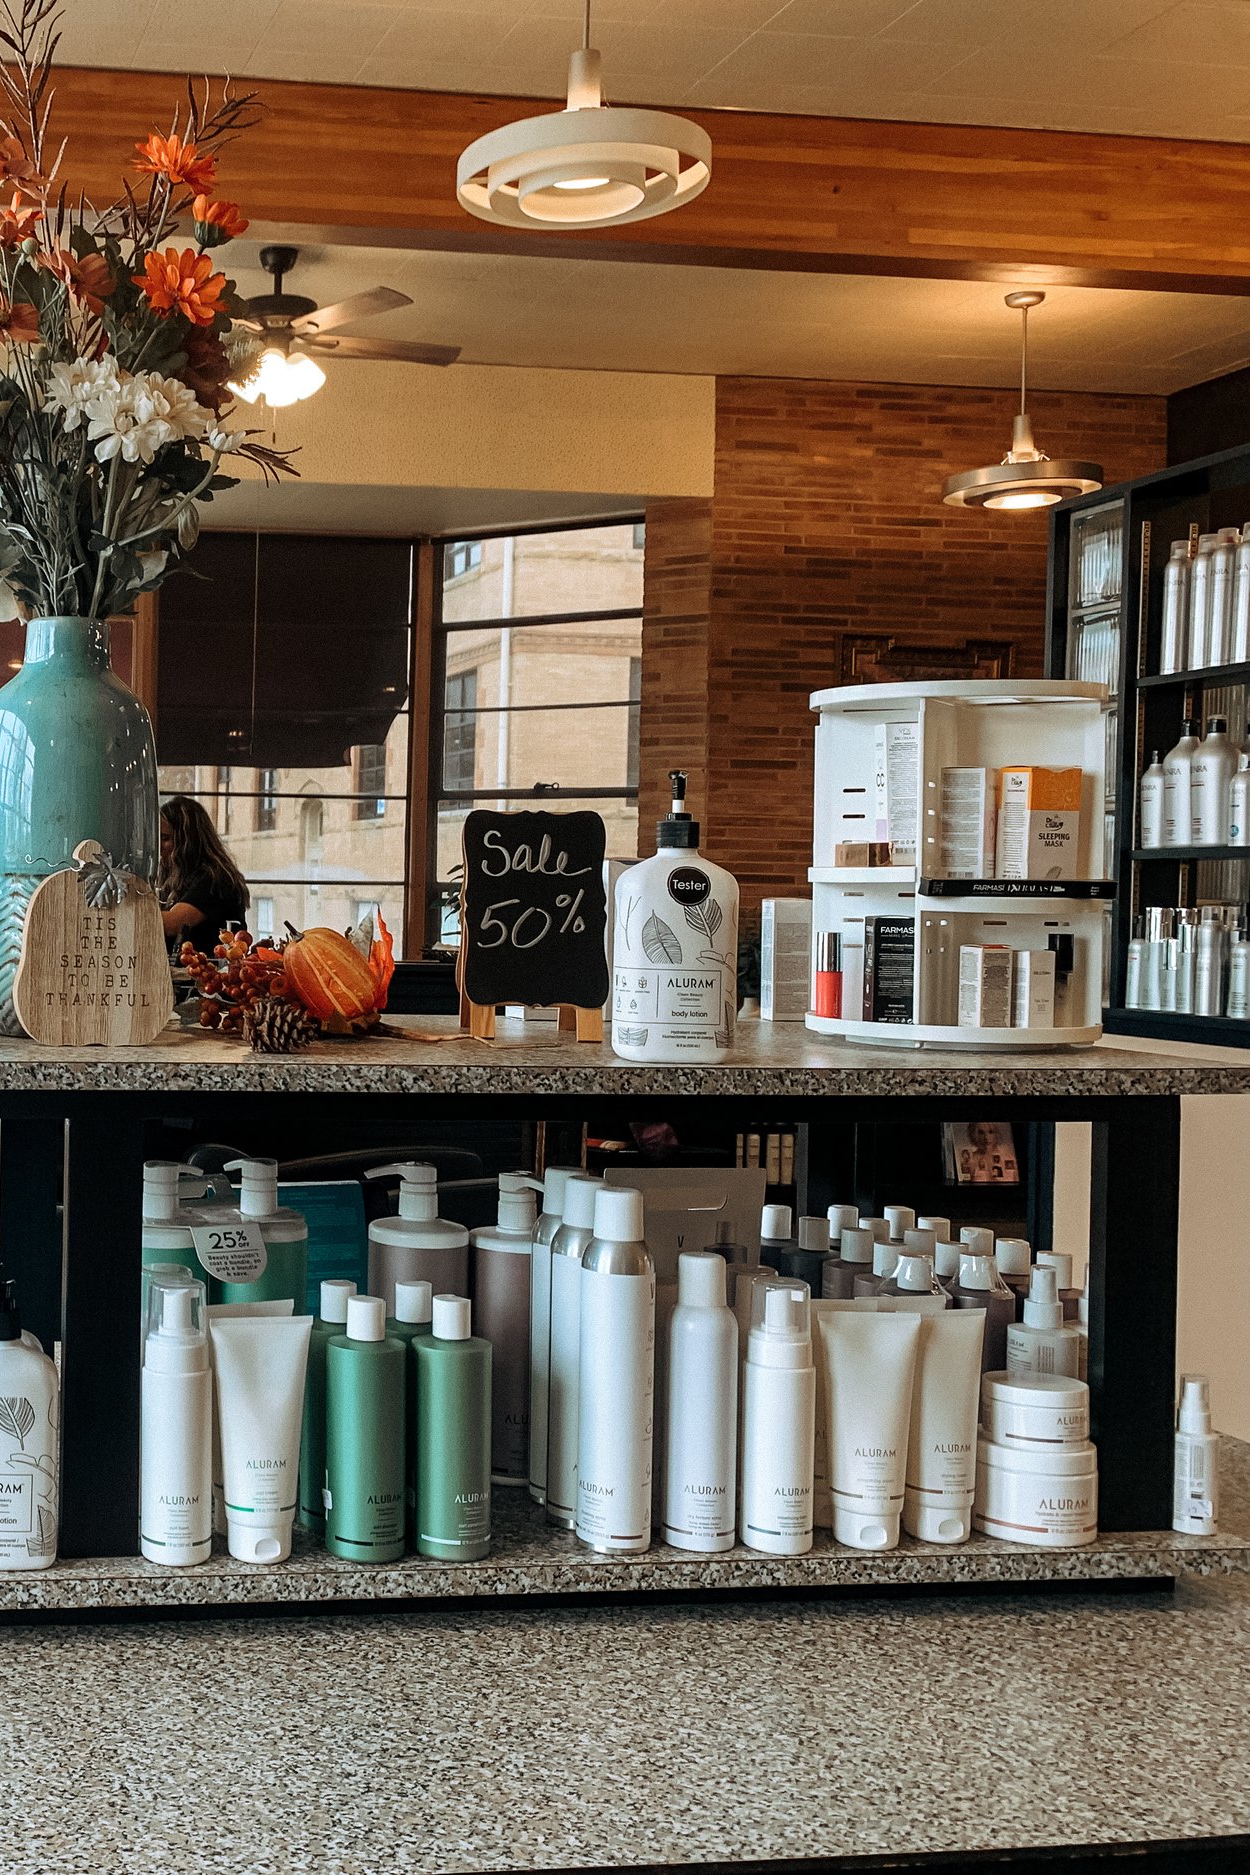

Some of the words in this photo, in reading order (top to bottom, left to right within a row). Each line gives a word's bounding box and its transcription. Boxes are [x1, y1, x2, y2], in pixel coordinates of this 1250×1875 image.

[1038, 832, 1070, 841] SLEEPING
[481, 830, 592, 877] Sale
[672, 878, 707, 891] Tester
[82, 916, 117, 931] TIS
[477, 889, 586, 948] 50%
[880, 926, 915, 934] FARMAS
[80, 936, 117, 949] THE
[60, 955, 138, 969] SEASON
[68, 973, 90, 987] TO
[105, 974, 129, 988] BE
[667, 978, 714, 989] ALURAM
[45, 992, 151, 1007] THANKFUL
[671, 1010, 688, 1018] body
[689, 1010, 708, 1018] lotion
[208, 1229, 248, 1250] 25%
[504, 1413, 530, 1425] ALU
[854, 1447, 897, 1458] ALURAM
[934, 1443, 972, 1453] ALURAM
[245, 1459, 287, 1469] ALURAM
[579, 1479, 615, 1497] ALURAM
[684, 1485, 727, 1495] ALURAM
[774, 1487, 810, 1497] ALURAM
[158, 1495, 200, 1506] ALURAM
[367, 1493, 401, 1504] ALURAM
[454, 1492, 489, 1504] ALURAM
